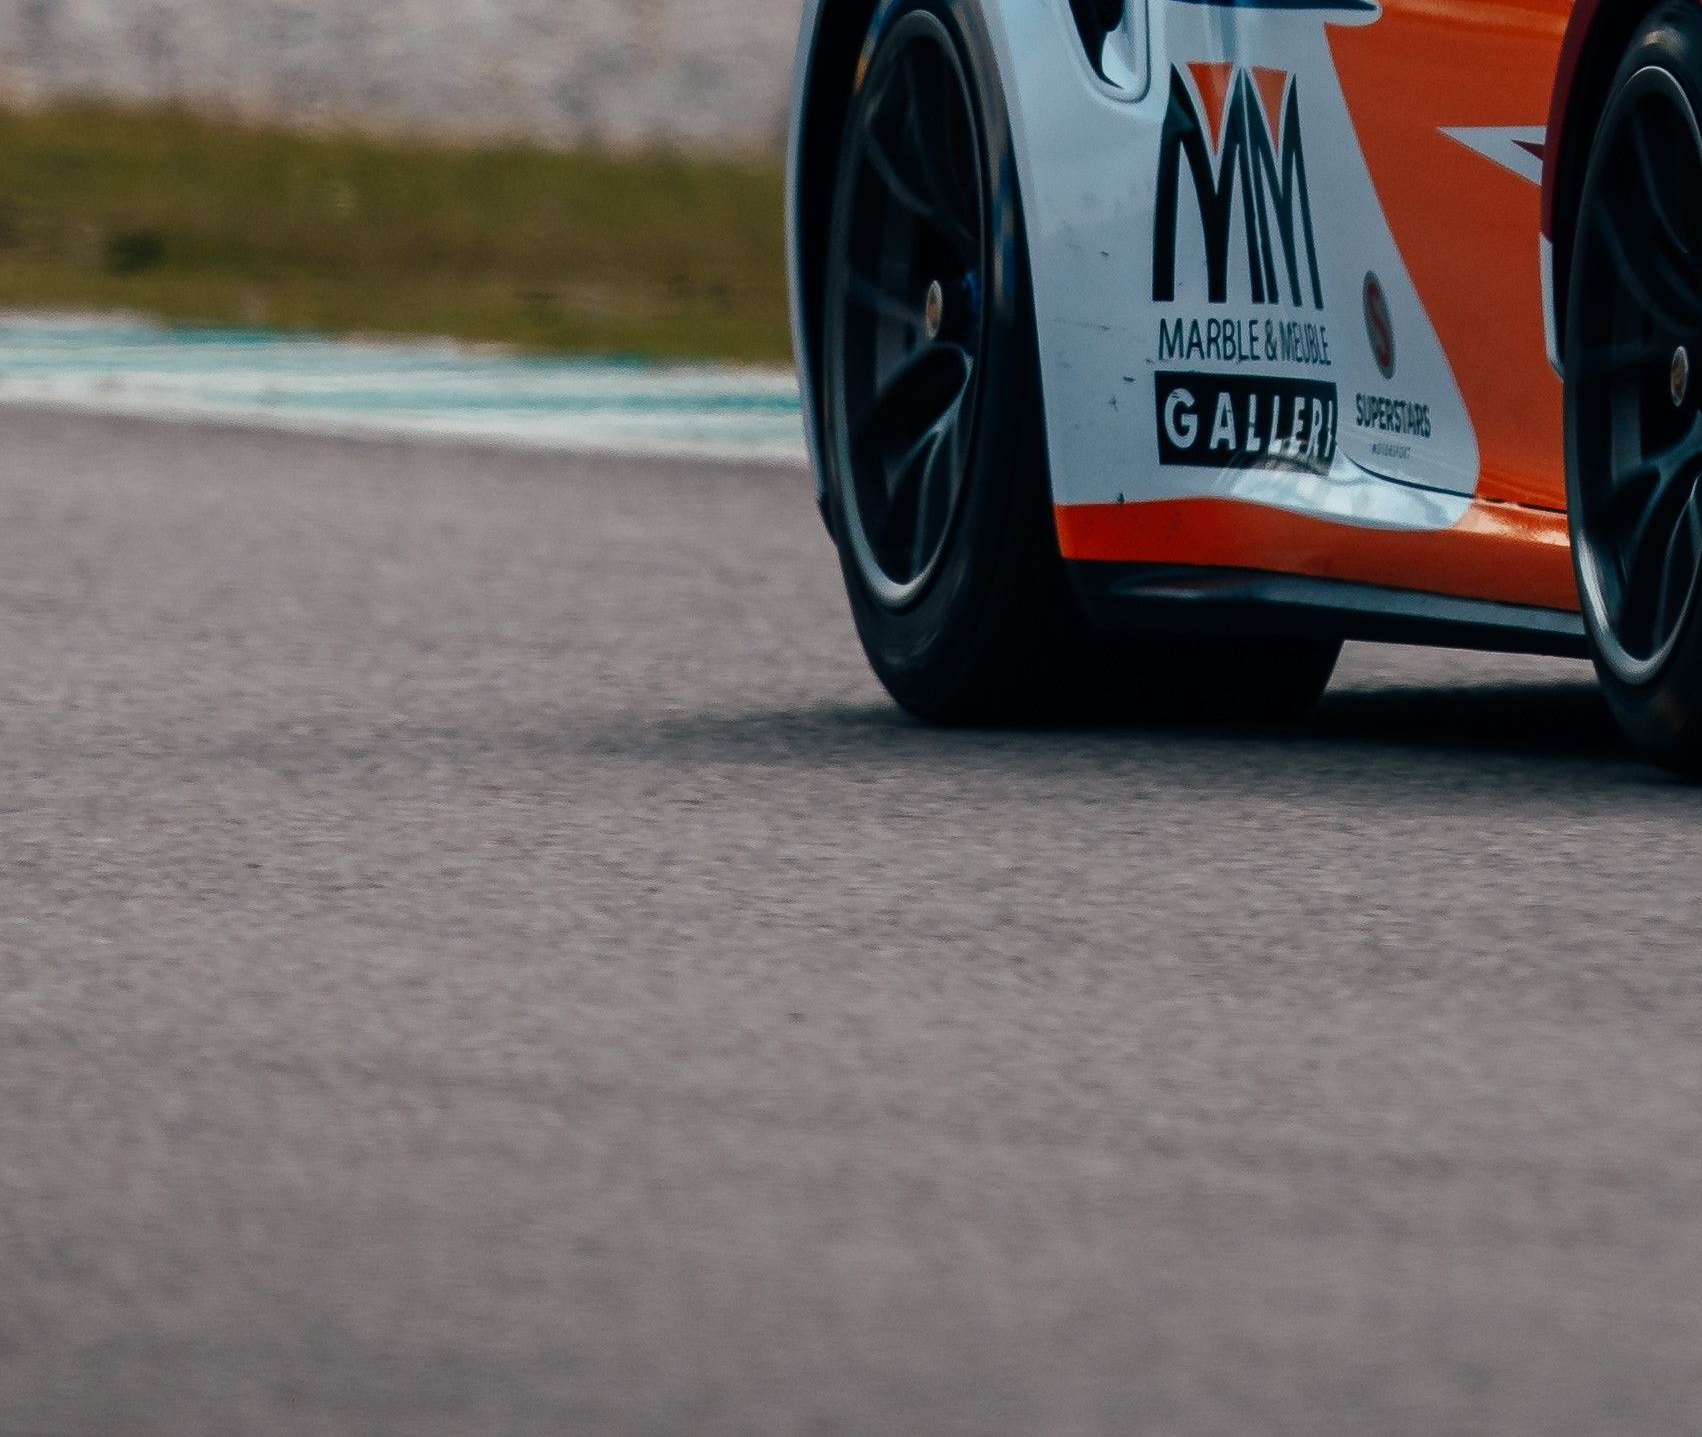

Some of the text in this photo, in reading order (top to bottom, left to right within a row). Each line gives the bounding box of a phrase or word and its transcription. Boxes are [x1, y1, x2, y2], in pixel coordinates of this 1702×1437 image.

[1158, 318, 1332, 366] MARBLE & MEUBLE
[1163, 386, 1338, 461] GALLERI
[1355, 392, 1431, 438] SUPERSTARS
